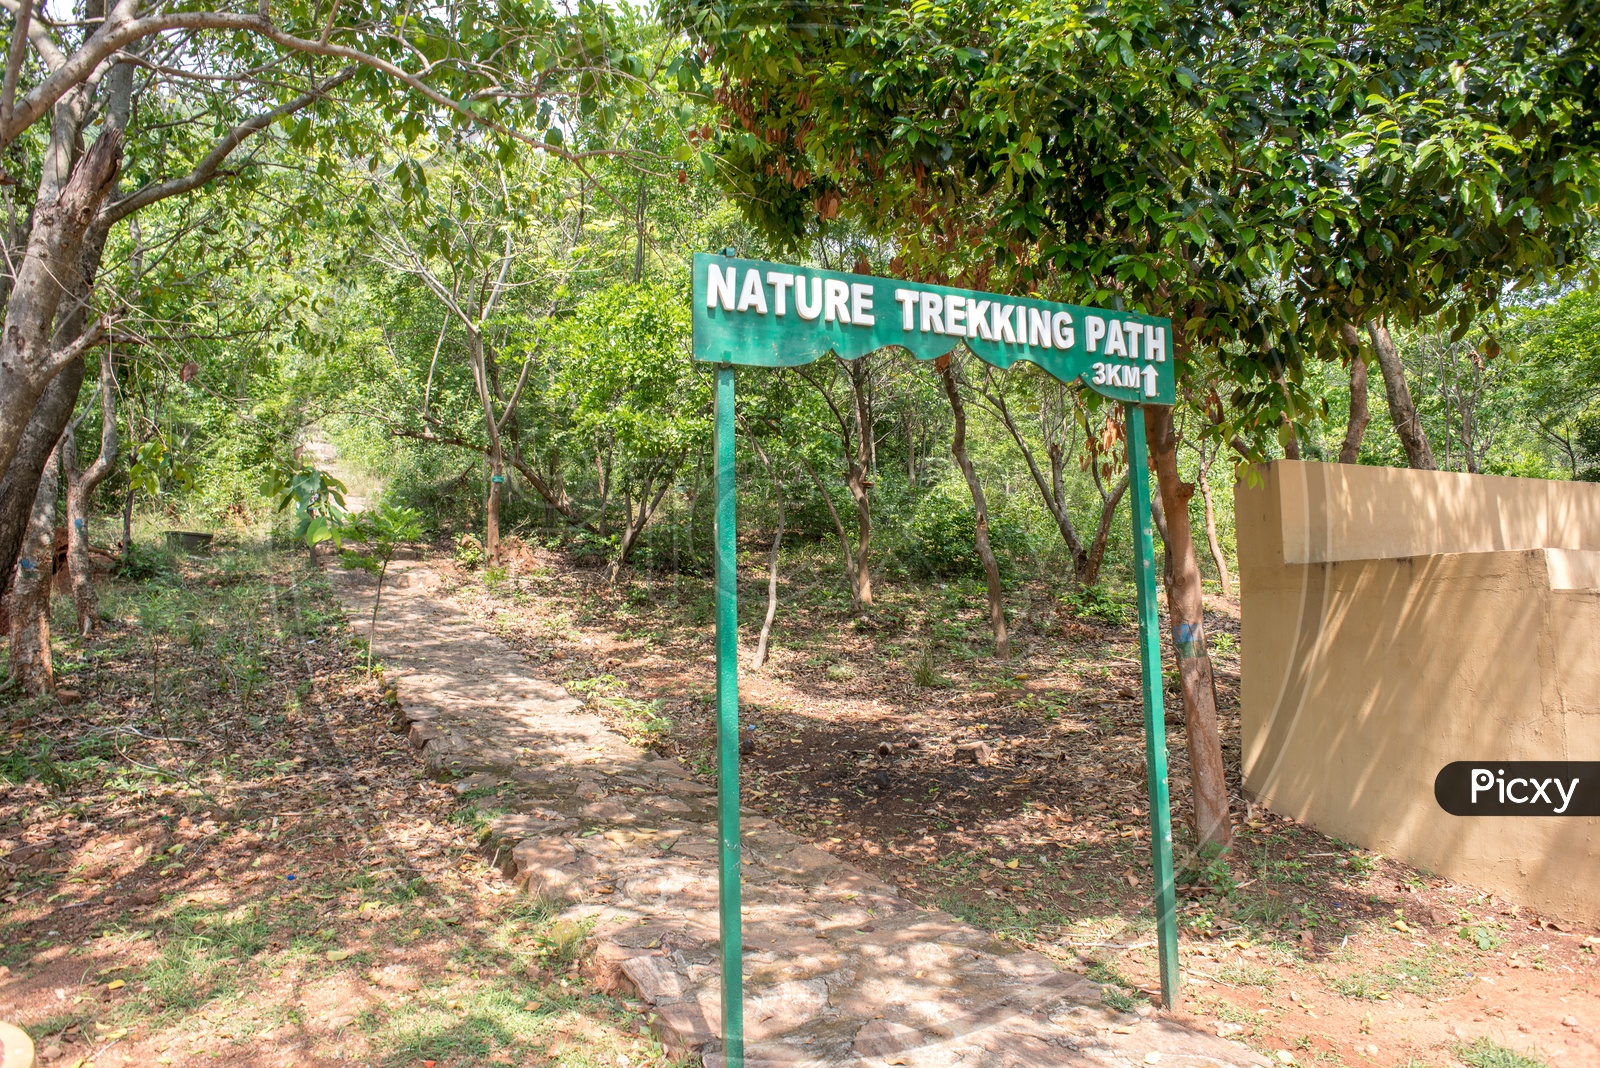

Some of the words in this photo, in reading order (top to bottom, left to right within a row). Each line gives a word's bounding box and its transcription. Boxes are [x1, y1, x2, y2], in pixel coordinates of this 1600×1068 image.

[706, 263, 875, 326] NATURE
[895, 288, 1075, 350] TREKKING
[1085, 315, 1165, 362] PATH
[1092, 362, 1141, 389] 3KM
